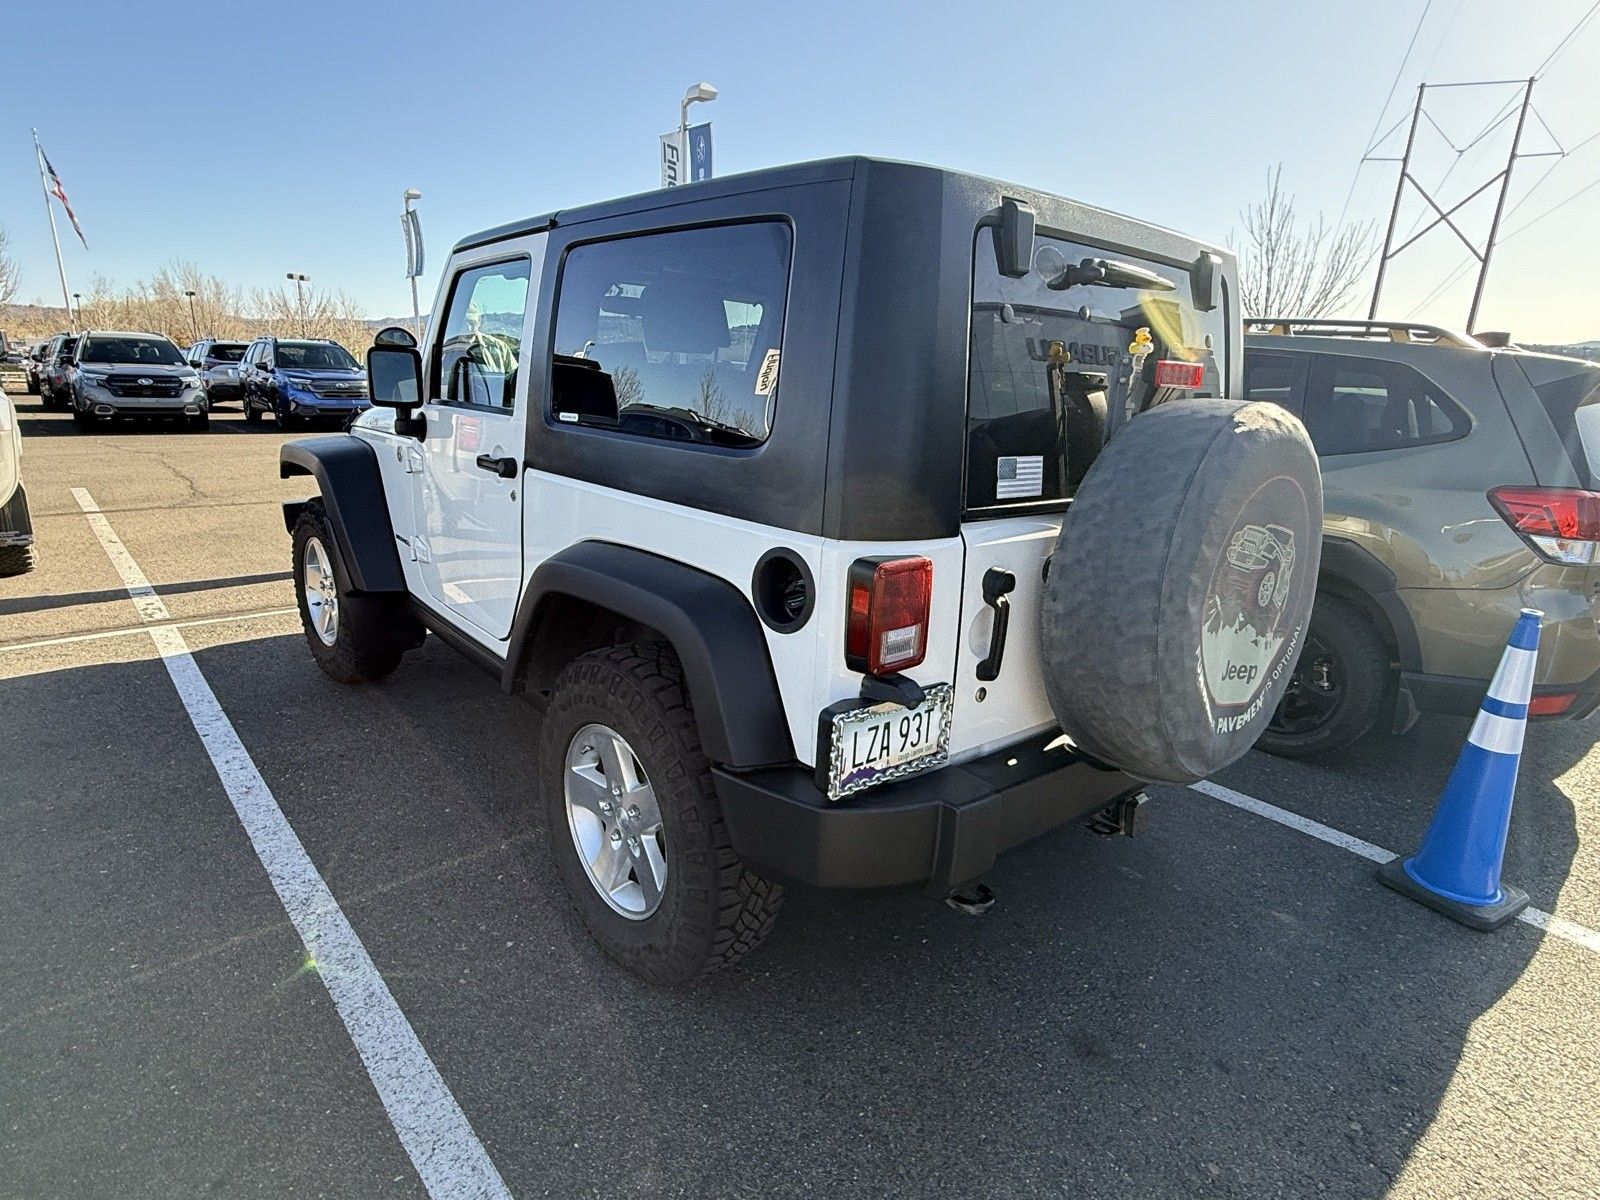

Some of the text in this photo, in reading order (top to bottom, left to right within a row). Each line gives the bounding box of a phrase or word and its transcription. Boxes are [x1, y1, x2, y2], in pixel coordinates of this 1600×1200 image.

[1222, 660, 1258, 684] Jeep
[851, 708, 935, 769] LZA 93T
